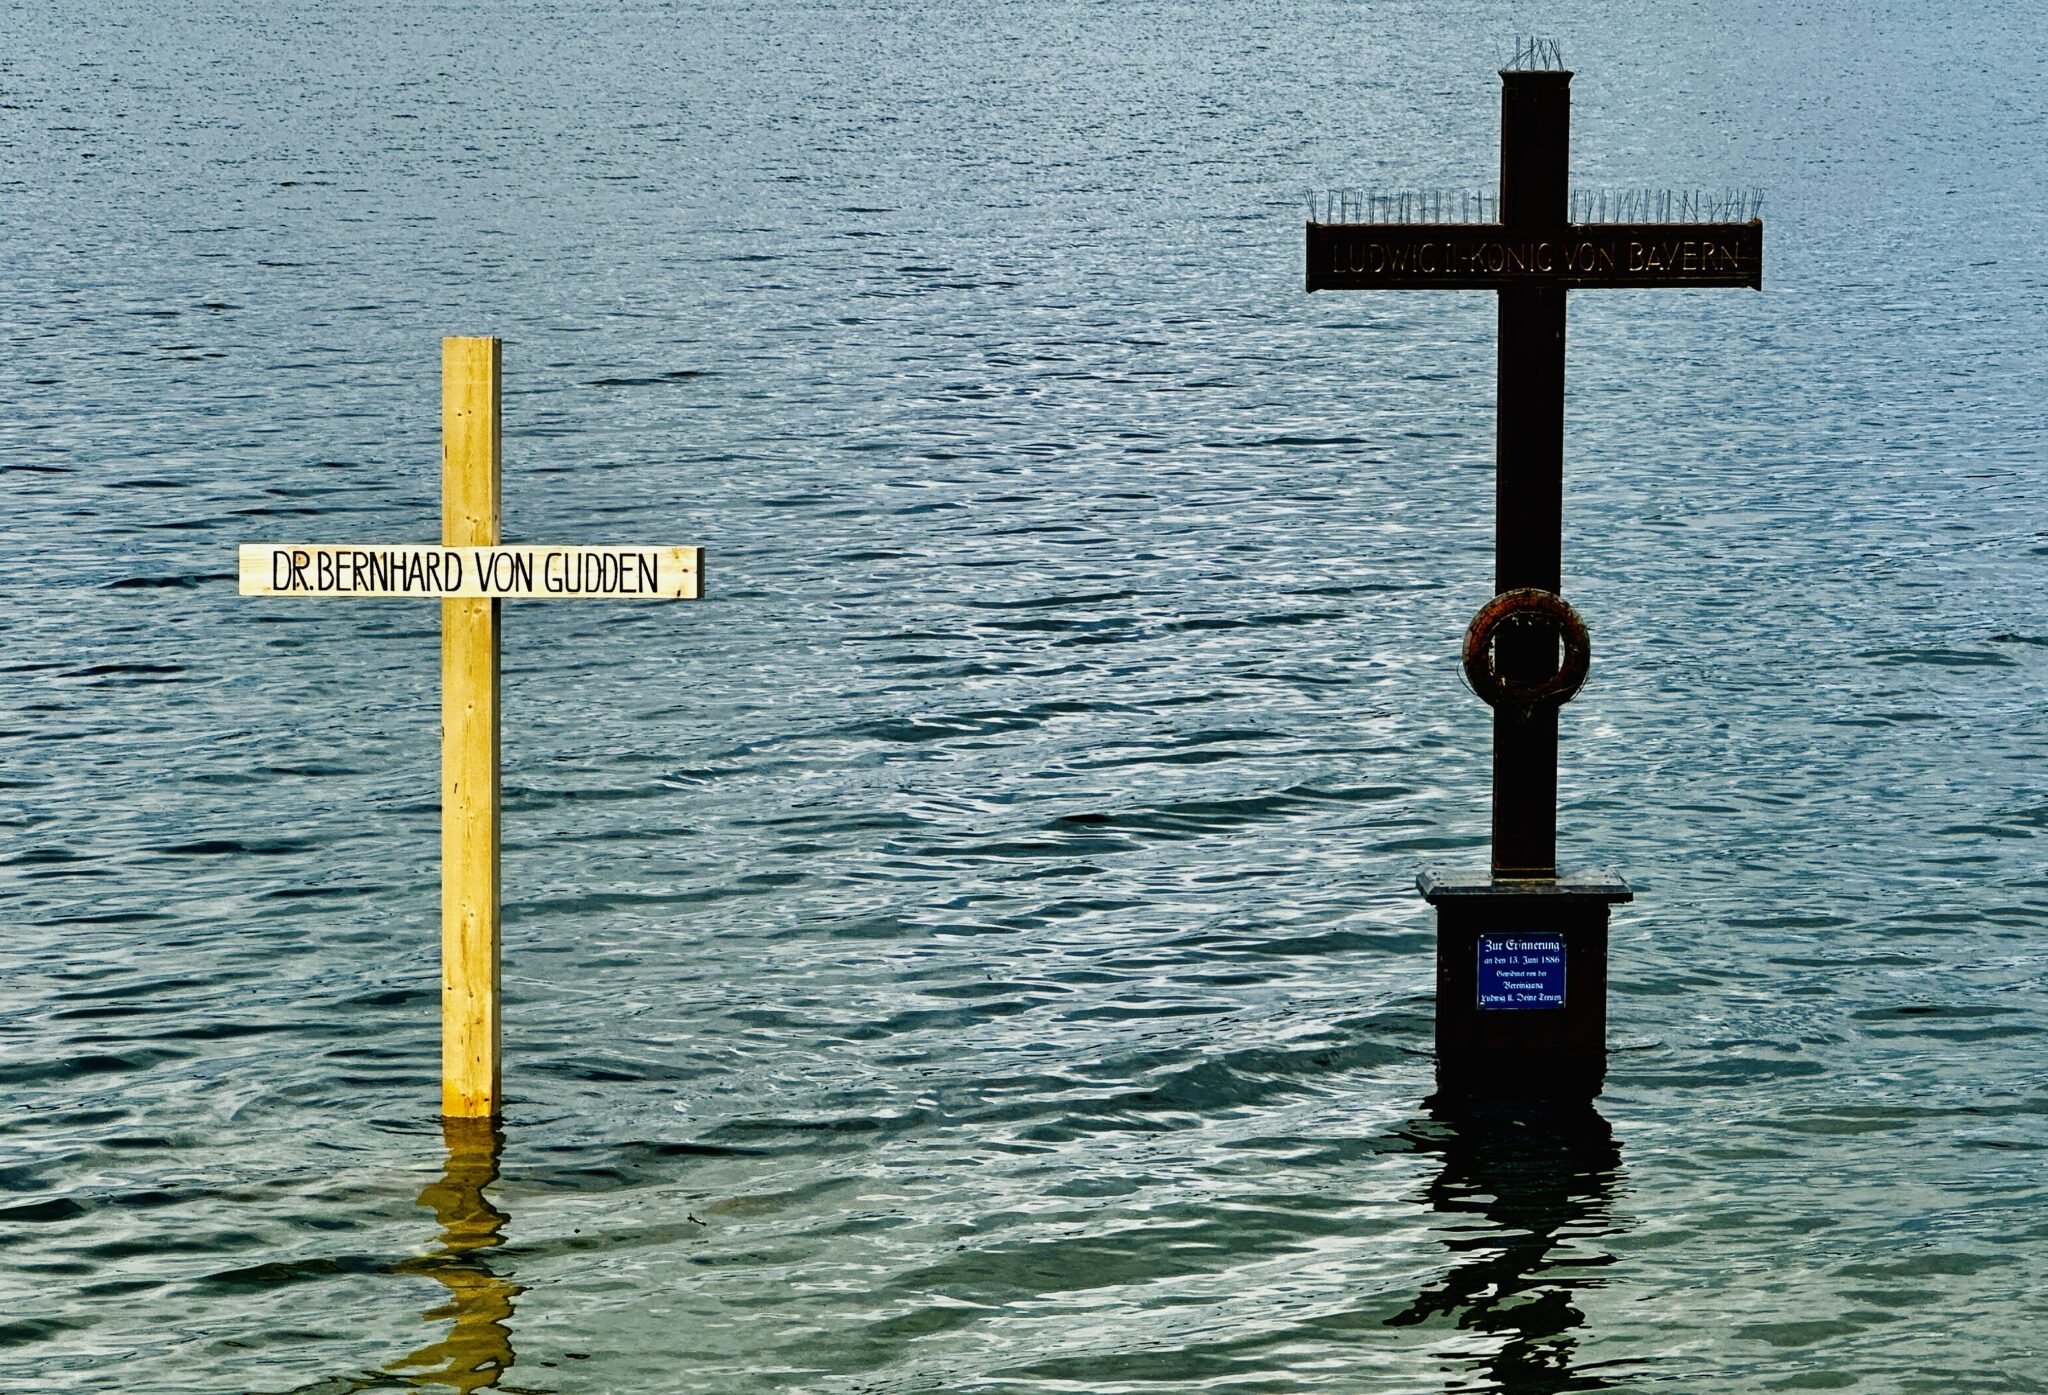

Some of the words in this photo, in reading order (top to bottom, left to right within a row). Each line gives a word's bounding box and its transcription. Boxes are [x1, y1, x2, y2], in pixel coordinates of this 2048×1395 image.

[1563, 241, 1615, 272] VON
[1628, 241, 1740, 272] BAYERN
[474, 551, 533, 594] VON
[544, 552, 659, 594] GUDDEN
[1485, 939, 1503, 952] Zur
[1505, 939, 1560, 952] Erinnerung
[1522, 955, 1539, 965] Juni
[1541, 956, 1560, 964] 1886
